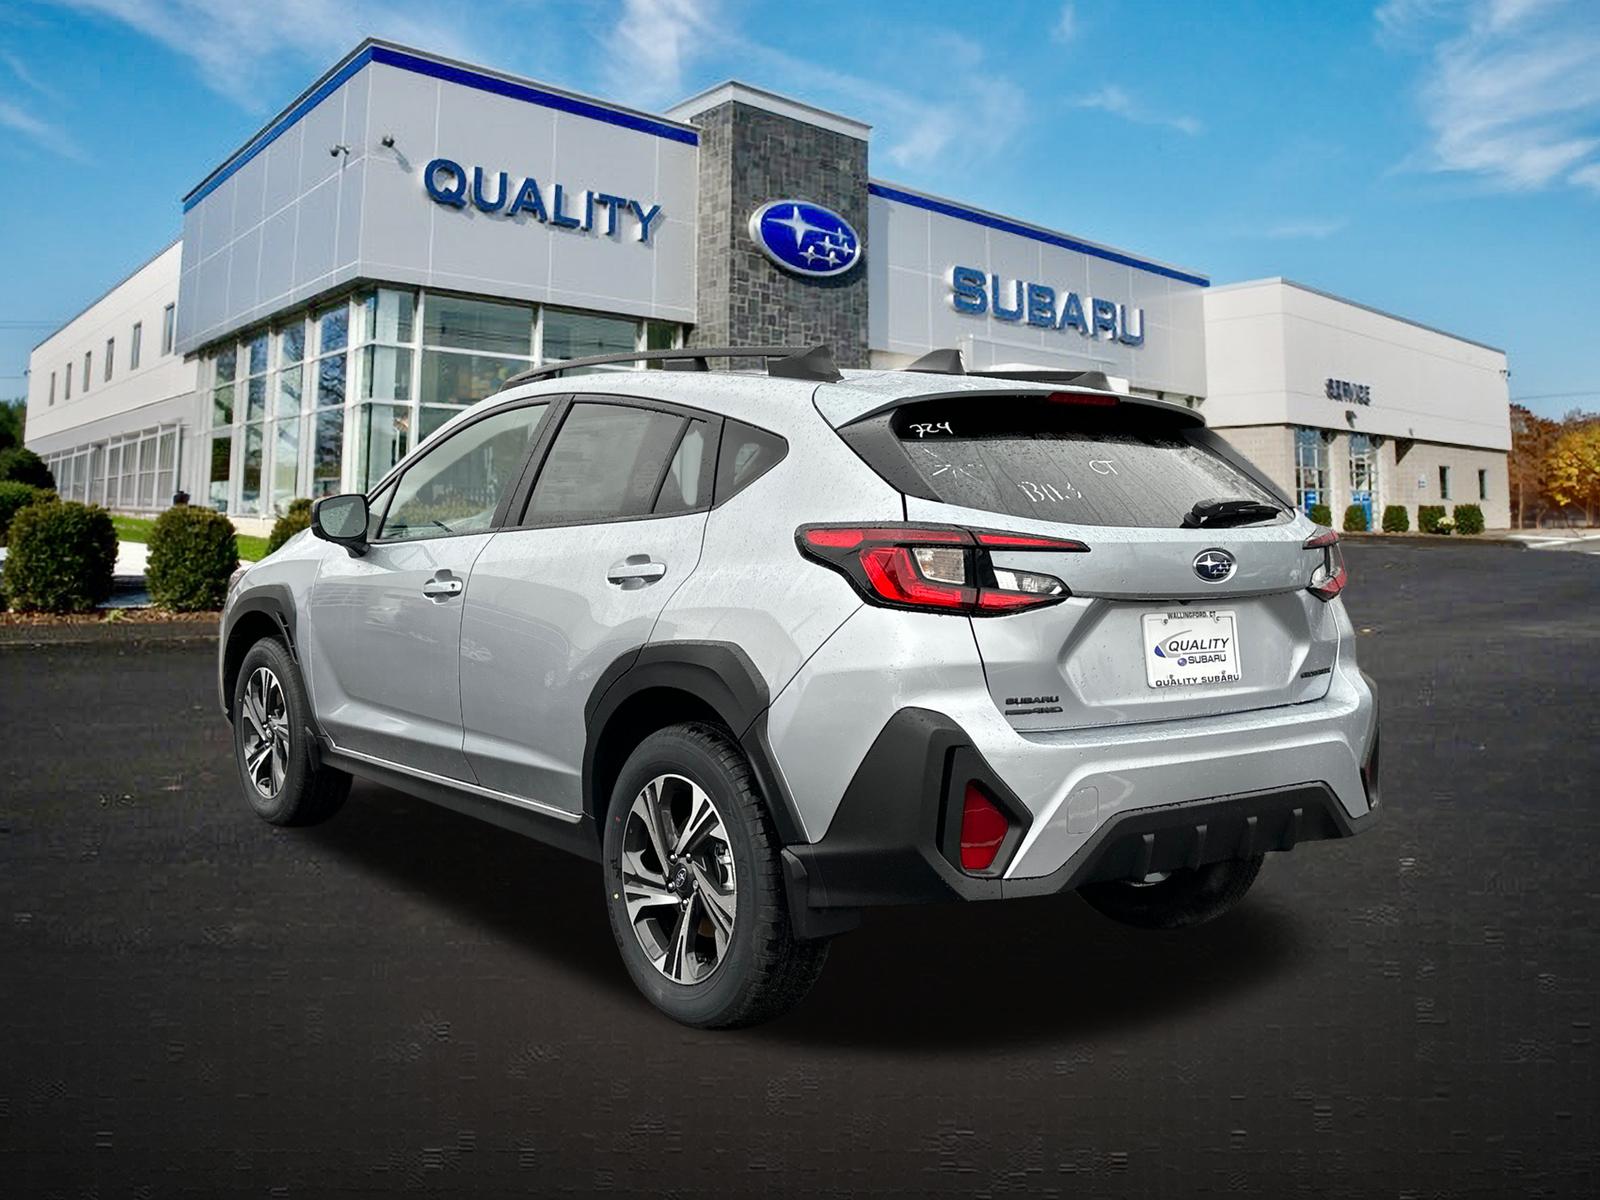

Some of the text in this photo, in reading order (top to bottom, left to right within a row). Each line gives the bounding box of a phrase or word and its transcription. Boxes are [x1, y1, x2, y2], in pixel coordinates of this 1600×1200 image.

[423, 157, 664, 243] QUALITY
[950, 265, 1145, 346] SUBARU
[1326, 378, 1371, 406] SERVICE
[1168, 638, 1229, 652] QUALITY
[1188, 654, 1226, 664] SUBARU
[1155, 674, 1240, 687] QUALITY SUBARU
[1005, 696, 1060, 705] SUBARU
